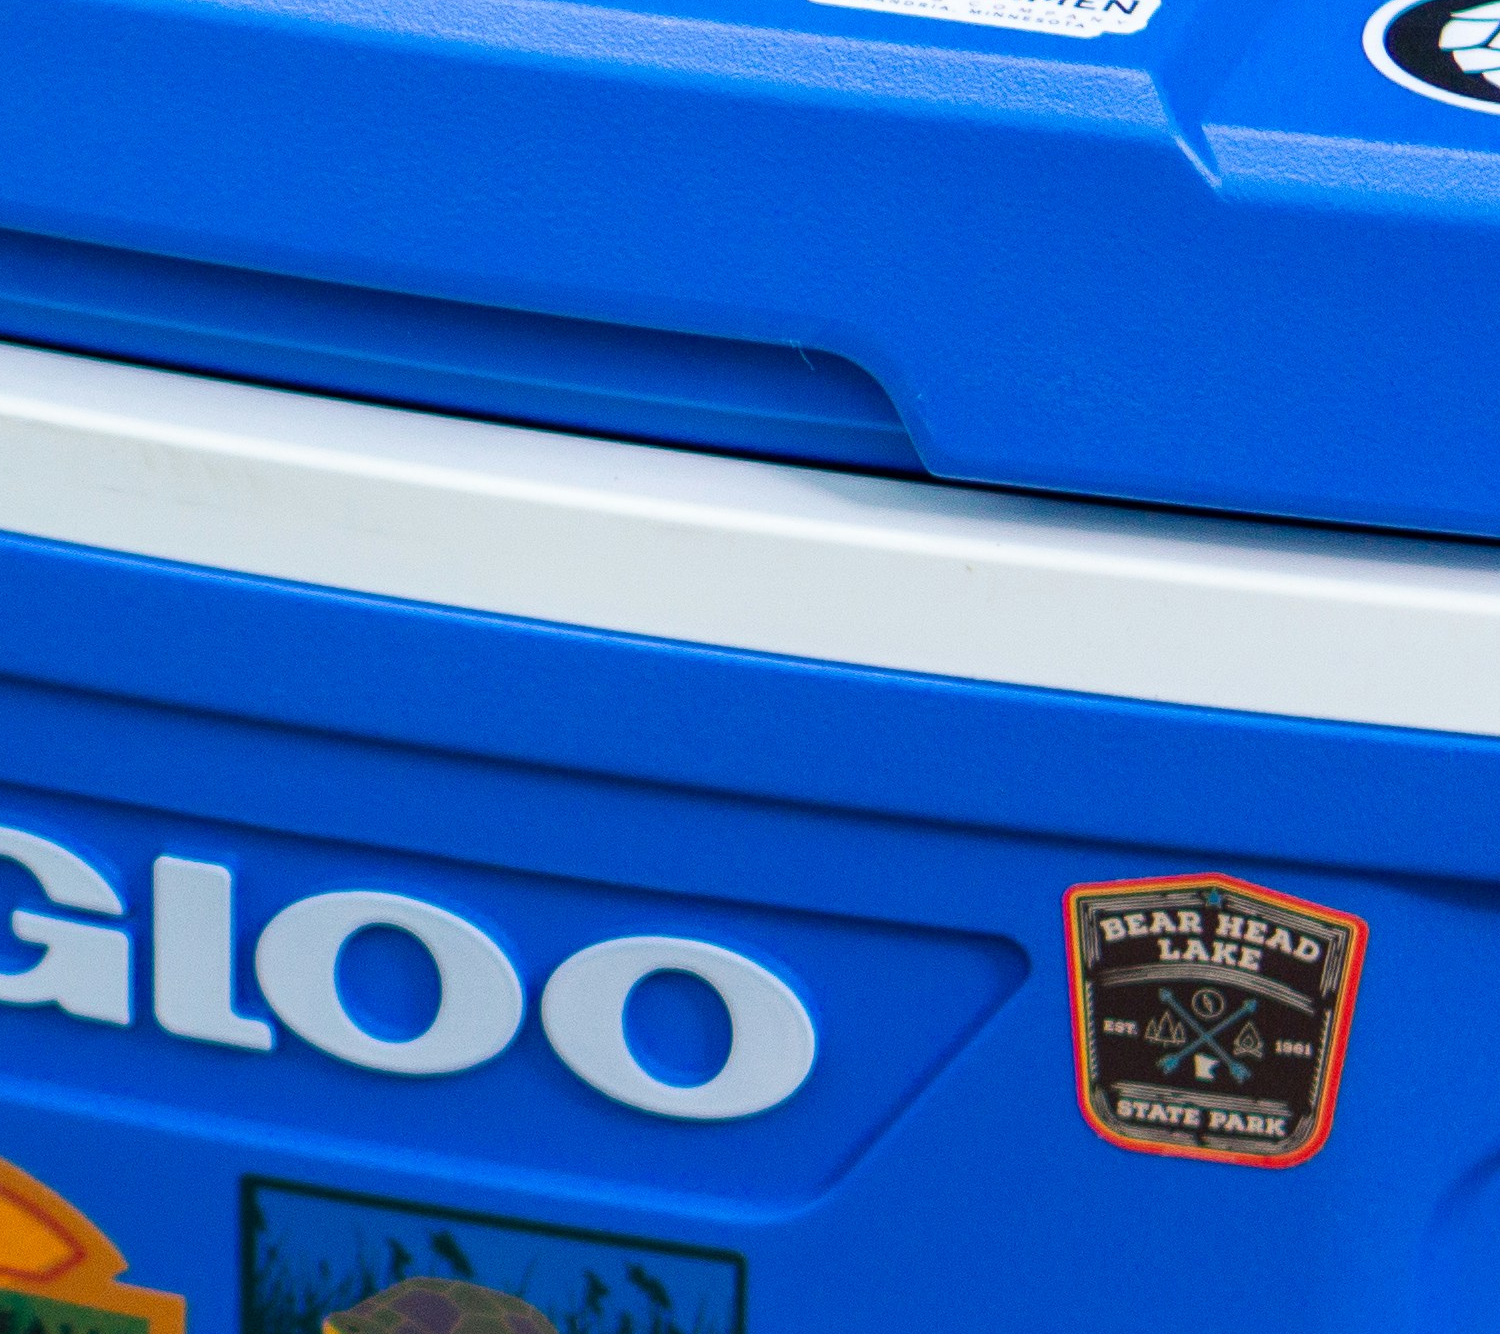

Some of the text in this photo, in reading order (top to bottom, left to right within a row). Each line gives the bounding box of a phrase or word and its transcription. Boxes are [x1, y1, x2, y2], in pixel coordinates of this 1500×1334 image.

[968, 0, 1128, 27] COMPANY
[968, 8, 1086, 30] MINNESOTA
[1100, 909, 1323, 964] BEAR HEAD
[1157, 939, 1263, 972] LAKE
[1116, 1099, 1288, 1138] STATE PARK
